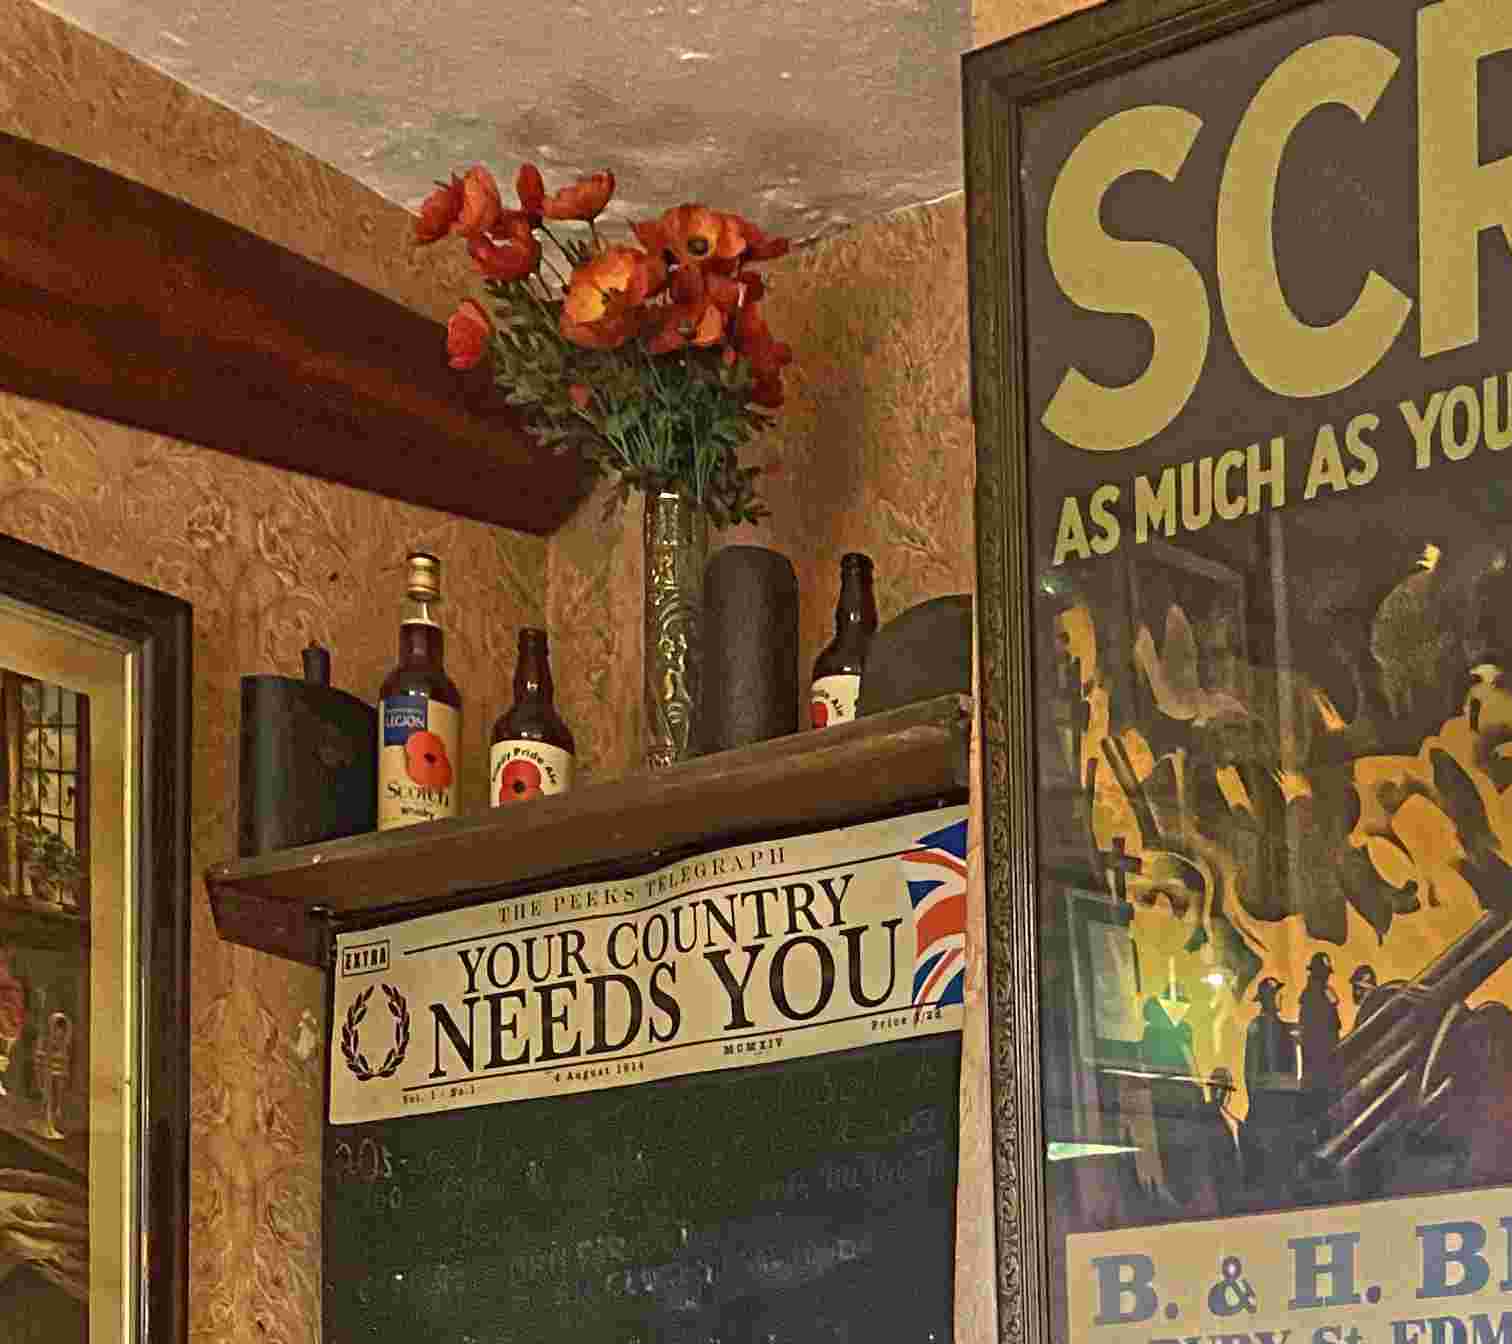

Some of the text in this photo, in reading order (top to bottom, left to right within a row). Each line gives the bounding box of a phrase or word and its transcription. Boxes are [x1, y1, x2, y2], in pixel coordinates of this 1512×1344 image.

[1053, 485, 1121, 566] AS
[1134, 437, 1286, 544] MUCH
[1303, 413, 1380, 500] AS
[498, 900, 542, 923] THE
[647, 847, 785, 897] TELEGRAPH
[344, 946, 387, 970] EXTRA
[458, 873, 854, 994] YOUR COUNTRY
[428, 918, 902, 1079] NEEDS YOU
[567, 1067, 610, 1081] August
[723, 1038, 784, 1055] MCMXIV
[1092, 1253, 1179, 1326] B.
[1207, 1256, 1257, 1317] &
[1287, 1231, 1381, 1312] H.
